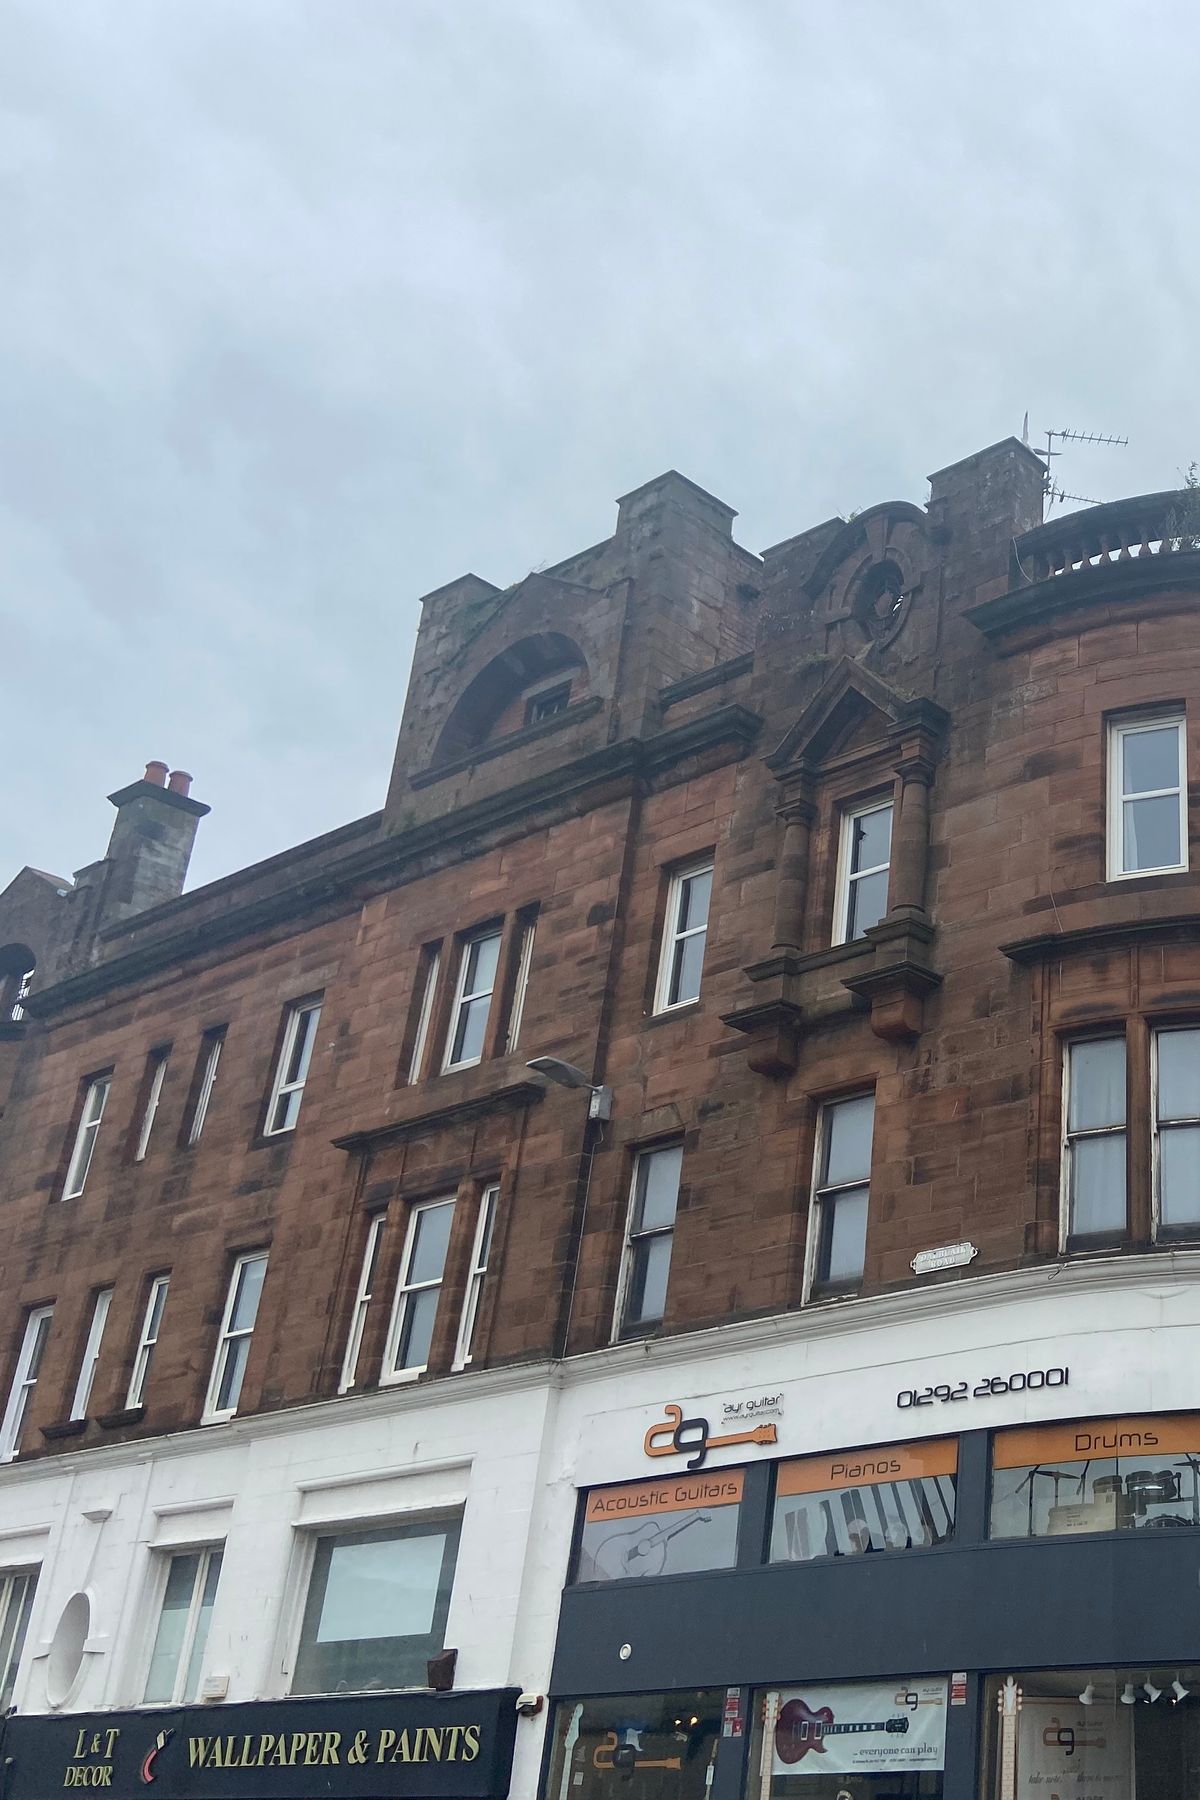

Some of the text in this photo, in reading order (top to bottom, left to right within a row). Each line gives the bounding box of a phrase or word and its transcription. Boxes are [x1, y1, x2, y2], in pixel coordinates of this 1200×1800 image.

[896, 1366, 1070, 1409] 01292 260001
[1075, 1432, 1159, 1452] Drums
[830, 1457, 901, 1481] Pianos
[592, 1480, 738, 1515] Acoustic Guitars
[187, 1724, 482, 1769] WALLPAPER & PAINTS
[63, 1765, 114, 1788] DECOR
